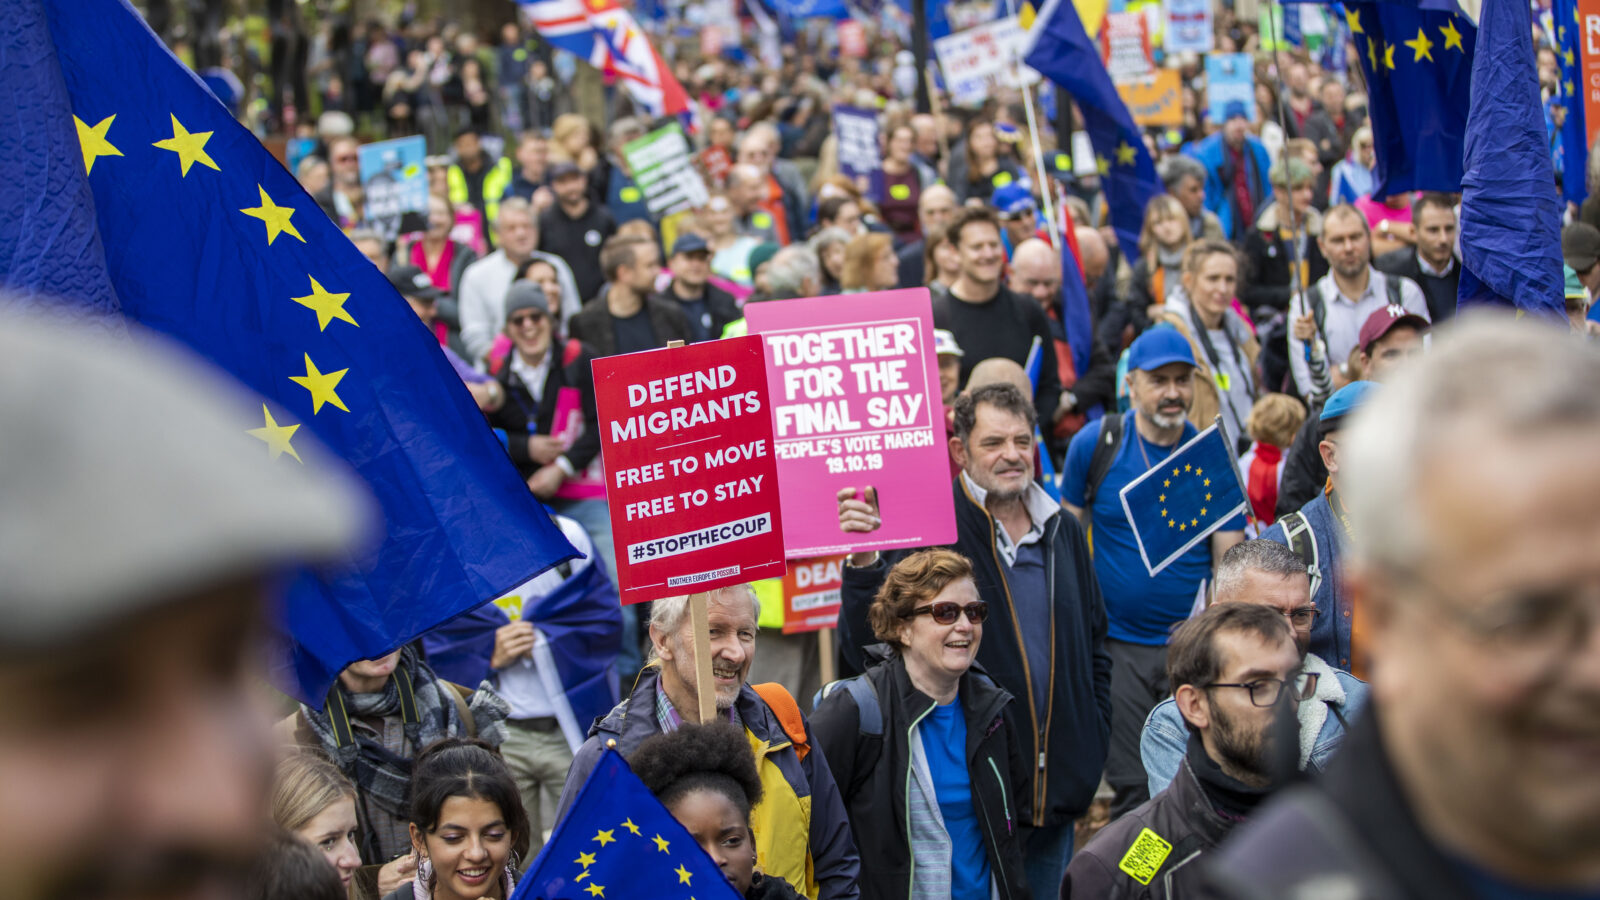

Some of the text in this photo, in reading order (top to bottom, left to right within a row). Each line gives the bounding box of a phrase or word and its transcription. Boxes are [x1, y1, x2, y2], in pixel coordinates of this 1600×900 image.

[767, 324, 917, 366] TOGETHER
[627, 364, 737, 408] DEFEND
[784, 359, 909, 400] FOR THE
[610, 390, 761, 444] MIGRANTS
[775, 393, 923, 437] FINAL SAY
[615, 439, 767, 489] FREE TO MOVE
[775, 430, 934, 460] PEOPLE'S VOTE MARCH
[825, 453, 884, 474] 19.10.19
[625, 474, 764, 522] FREE TO STAY
[632, 517, 767, 560] #STOPTHECOUP
[669, 576, 692, 586] ANOTHER
[692, 572, 712, 582] EUROPE
[716, 566, 739, 578] POSSIBLE
[795, 559, 844, 588] DEA
